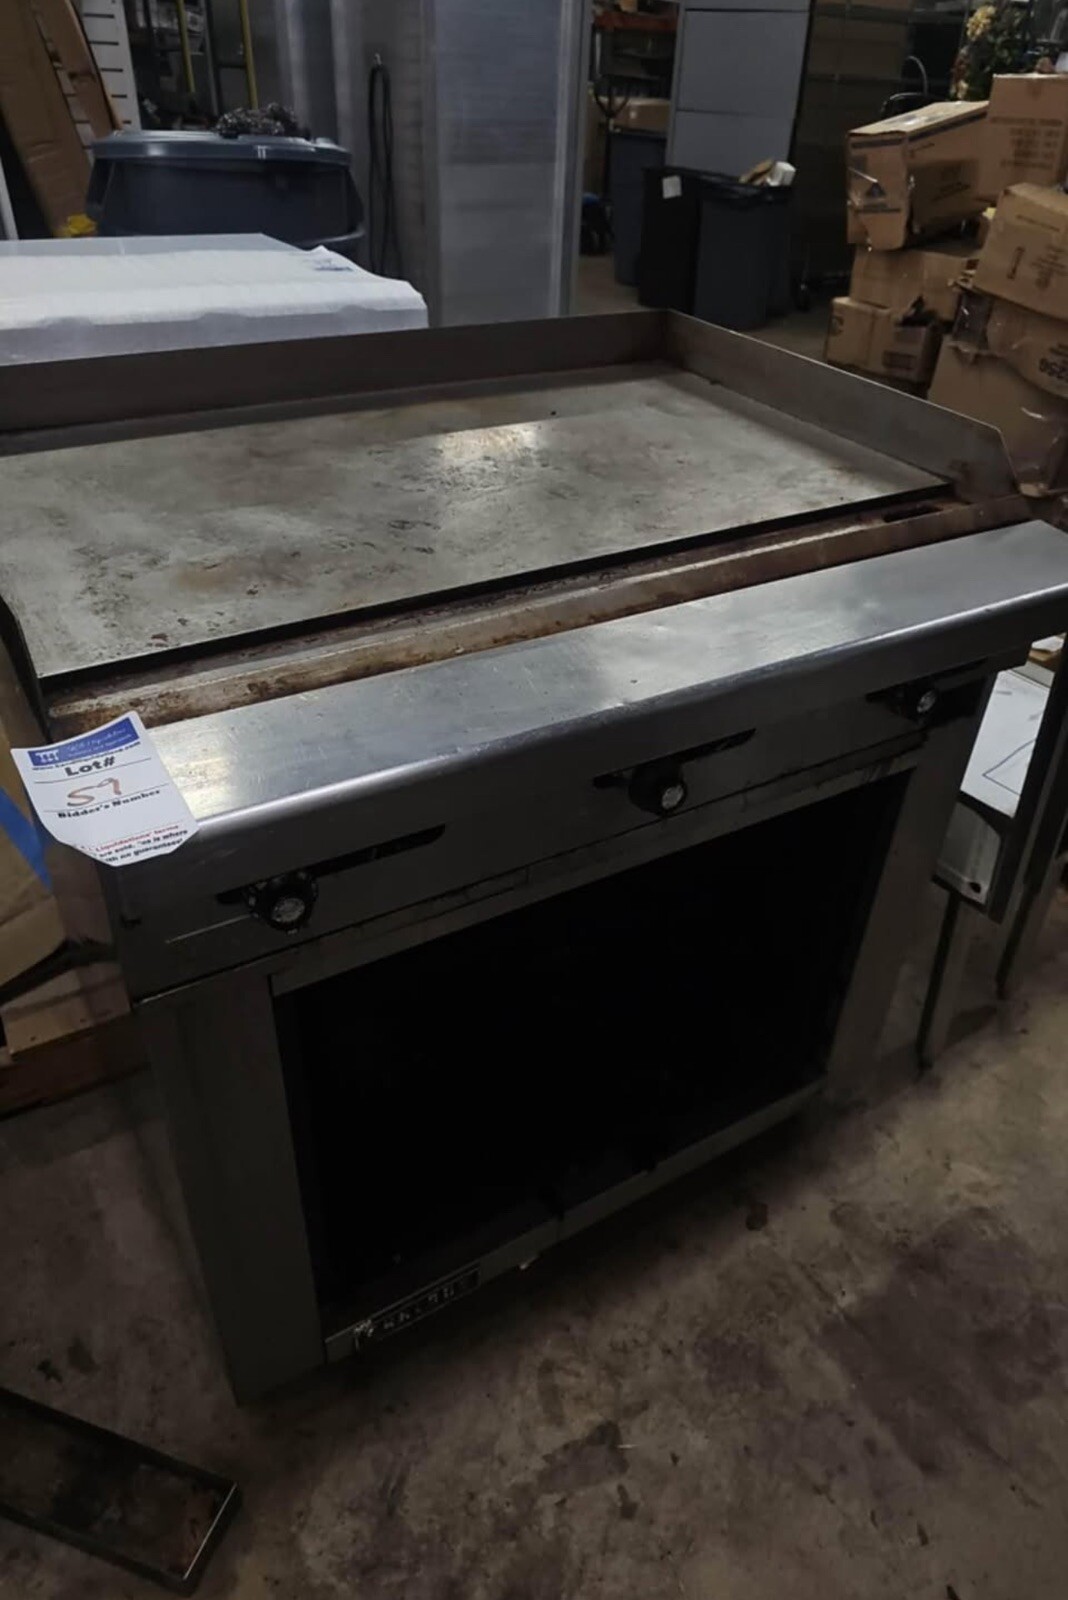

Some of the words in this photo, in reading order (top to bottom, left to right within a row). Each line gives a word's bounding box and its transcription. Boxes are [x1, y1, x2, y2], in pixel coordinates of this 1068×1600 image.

[65, 756, 116, 777] Lot#
[58, 804, 110, 819] Bidder's
[112, 789, 161, 807] Number
[162, 829, 189, 841] where
